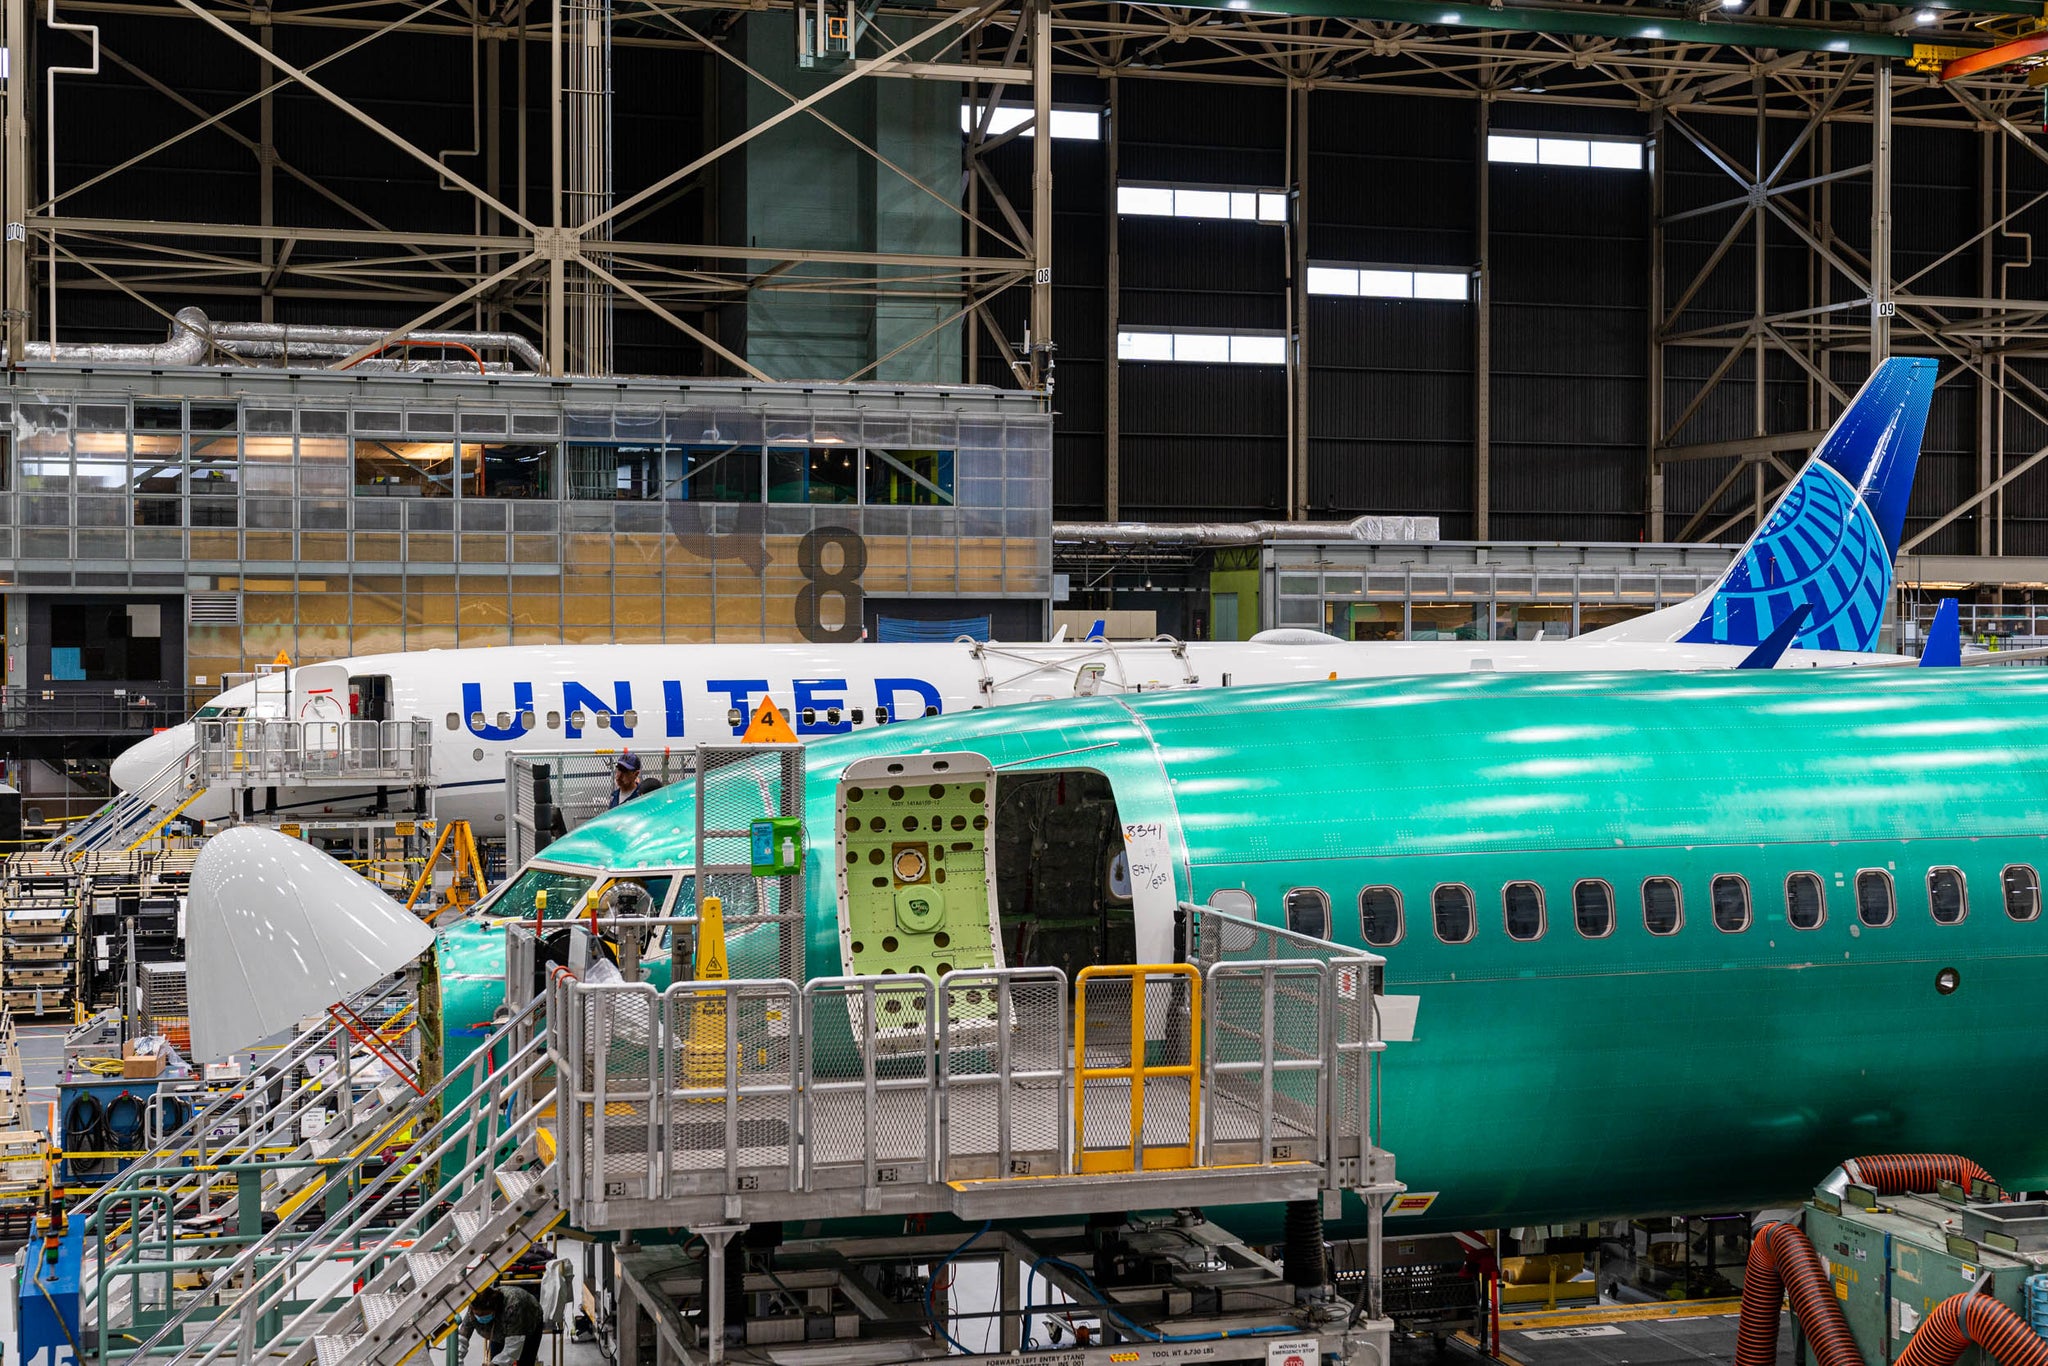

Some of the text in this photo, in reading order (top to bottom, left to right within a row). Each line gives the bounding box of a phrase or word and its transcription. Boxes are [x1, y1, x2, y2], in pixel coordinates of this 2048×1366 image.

[462, 679, 943, 741] UNITED
[761, 711, 775, 726] 4
[1126, 823, 1162, 840] 8341
[986, 1358, 1020, 1366] FORWARD
[1039, 1355, 1060, 1363] ENTRY
[1063, 1353, 1085, 1361] STAND
